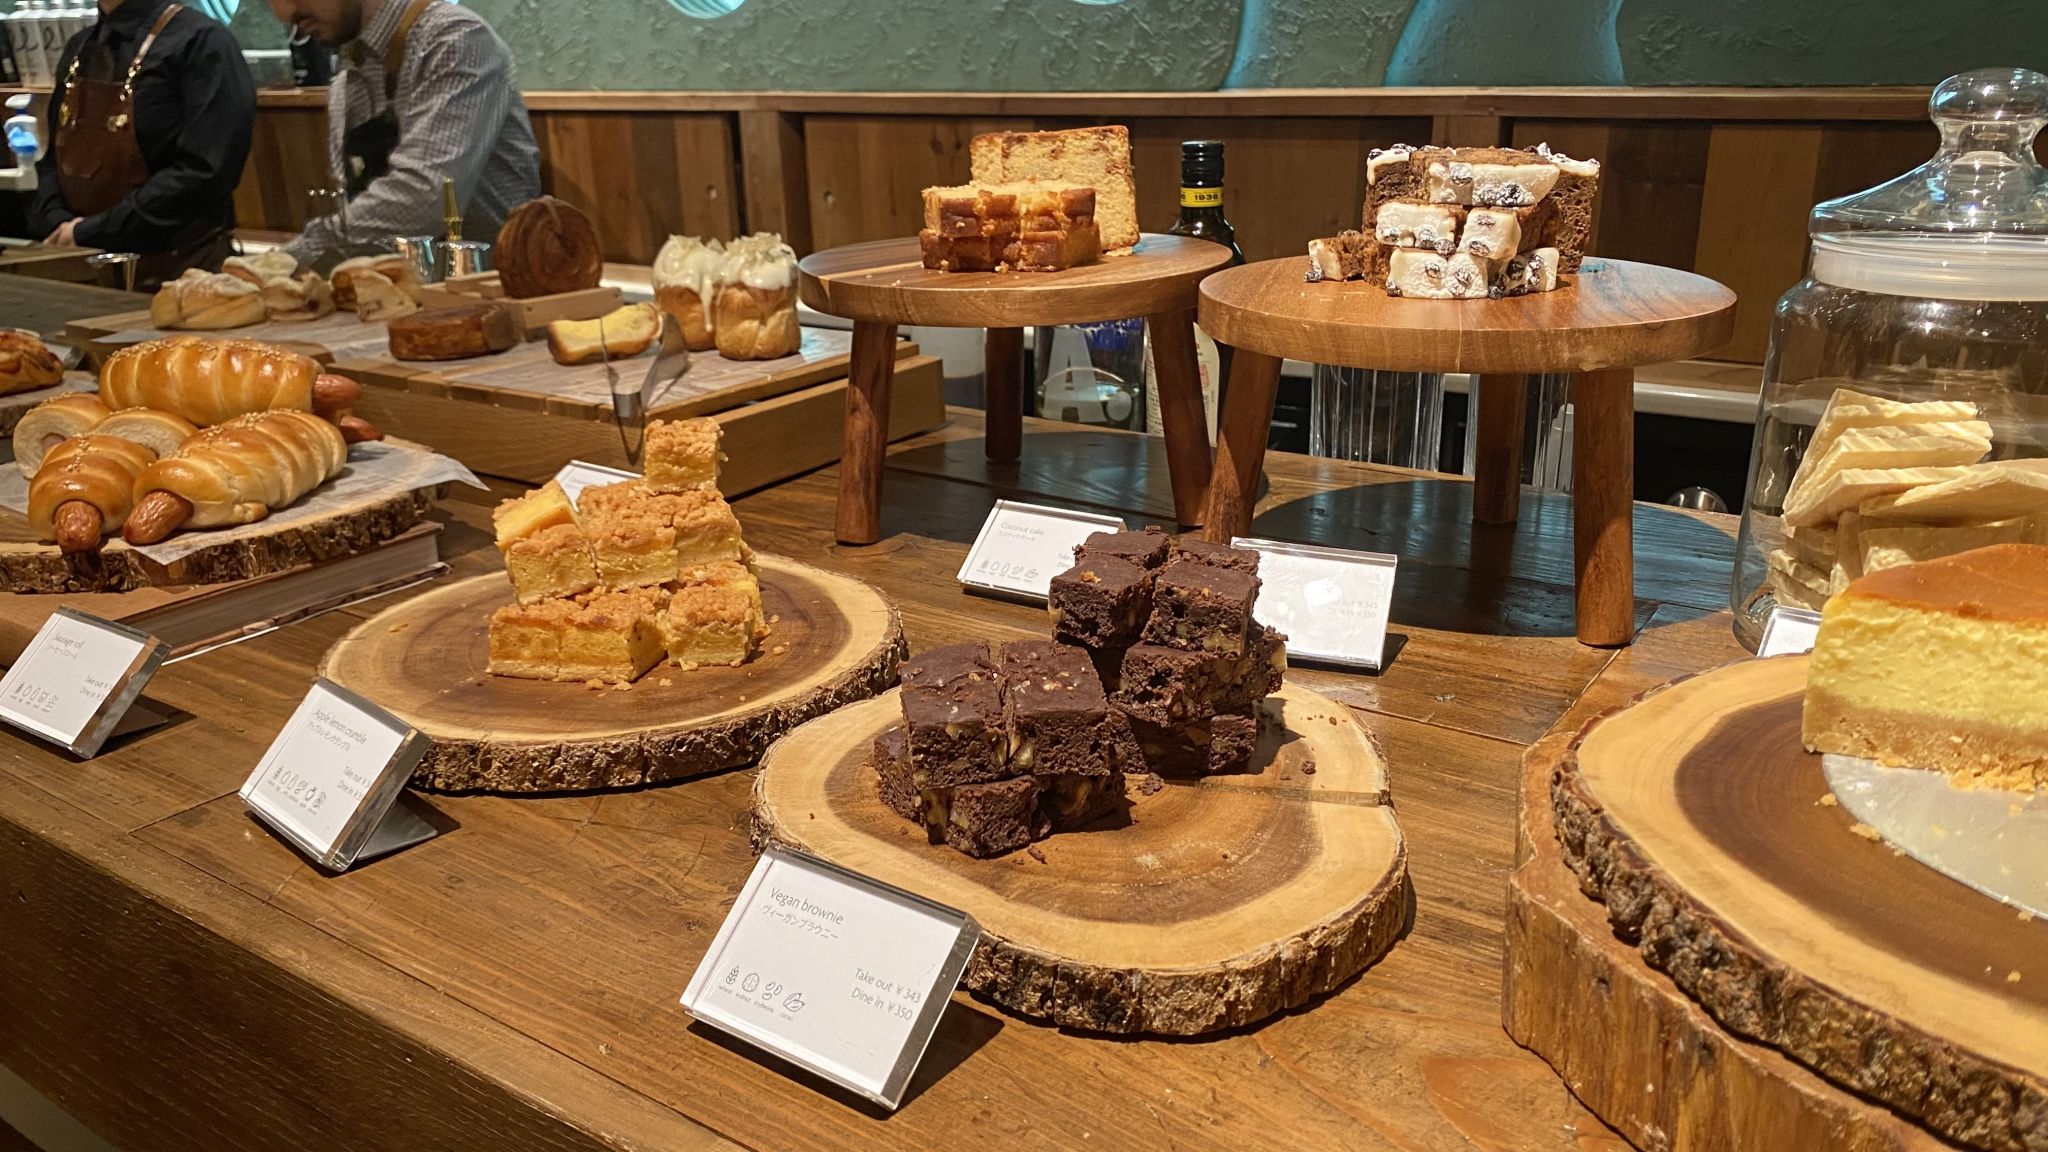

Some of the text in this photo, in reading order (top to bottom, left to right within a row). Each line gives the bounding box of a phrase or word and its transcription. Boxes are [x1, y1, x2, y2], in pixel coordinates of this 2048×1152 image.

[1194, 193, 1218, 201] 1936
[1000, 521, 1045, 537] Coconut cake
[53, 632, 75, 647] Sausage
[313, 709, 368, 745] Apple lemon crumble
[770, 887, 844, 925] Vegan brownie
[761, 905, 839, 939] ヴィーガンブラウニー
[855, 967, 875, 985] Take
[875, 979, 893, 992] out
[851, 987, 874, 1005] Dine
[874, 996, 884, 1009] in
